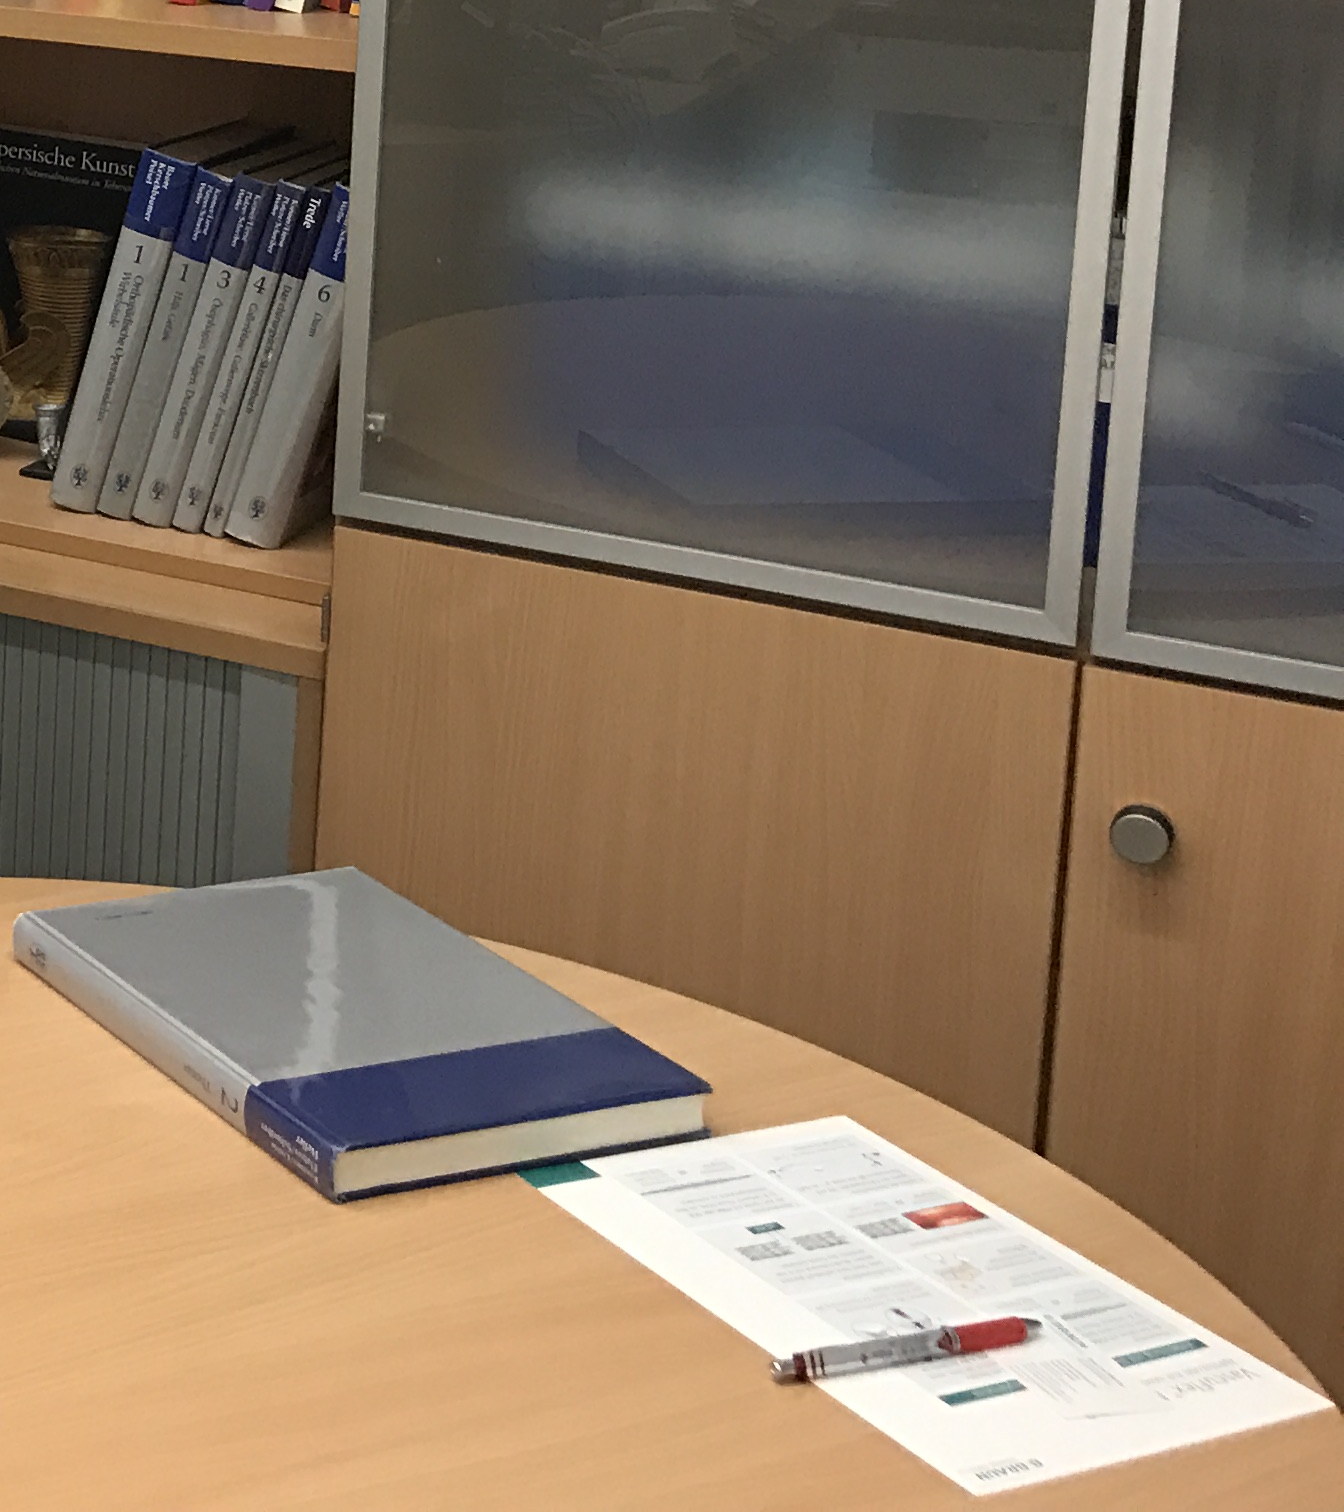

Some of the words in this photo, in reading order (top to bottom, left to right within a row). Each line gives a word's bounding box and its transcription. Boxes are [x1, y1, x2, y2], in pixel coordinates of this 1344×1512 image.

[81, 151, 136, 178] Kunst
[162, 164, 174, 190] Bauer
[304, 197, 321, 229] Trede
[133, 245, 143, 265] 1
[179, 263, 189, 283] 1
[216, 270, 232, 289] 3
[253, 276, 266, 295] 4
[317, 285, 331, 303] 6
[116, 273, 143, 347] Orthopädische
[220, 1086, 239, 1113] 2
